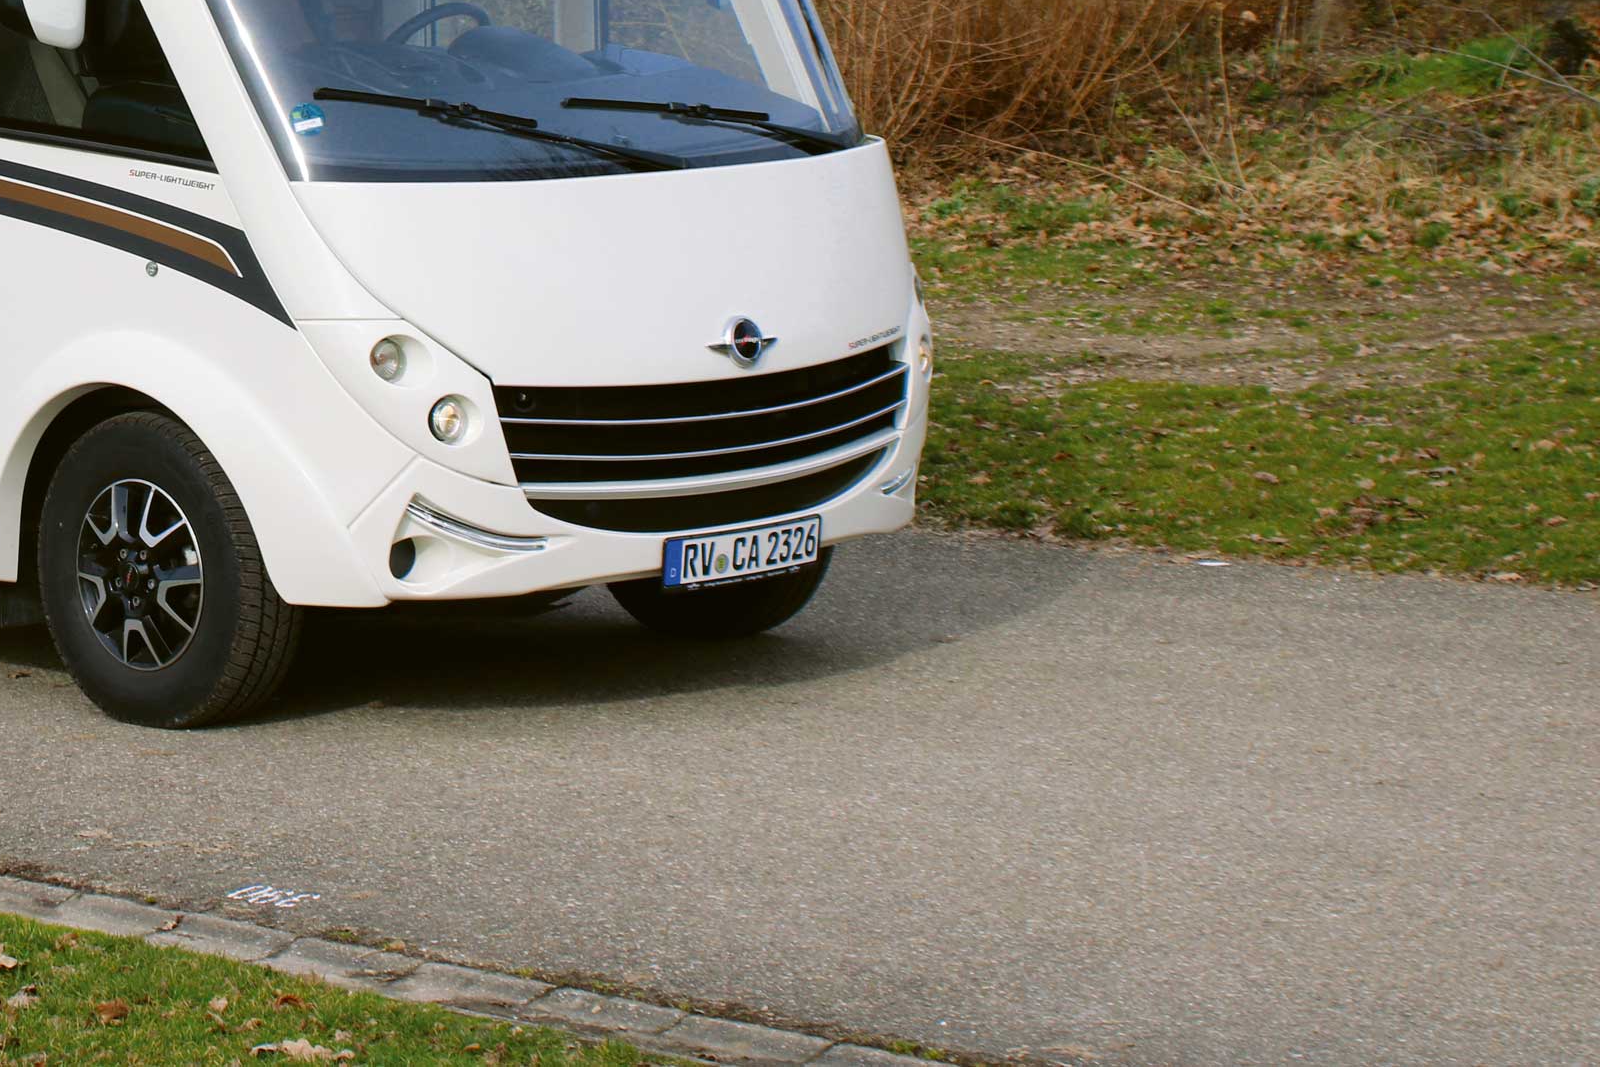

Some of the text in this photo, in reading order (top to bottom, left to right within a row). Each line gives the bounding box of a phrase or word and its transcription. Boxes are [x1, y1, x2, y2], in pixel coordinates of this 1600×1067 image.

[129, 169, 215, 190] SUPER-LIGHTWEIGHT
[683, 541, 715, 579] RV
[733, 535, 759, 571] CA
[766, 524, 817, 566] 2326
